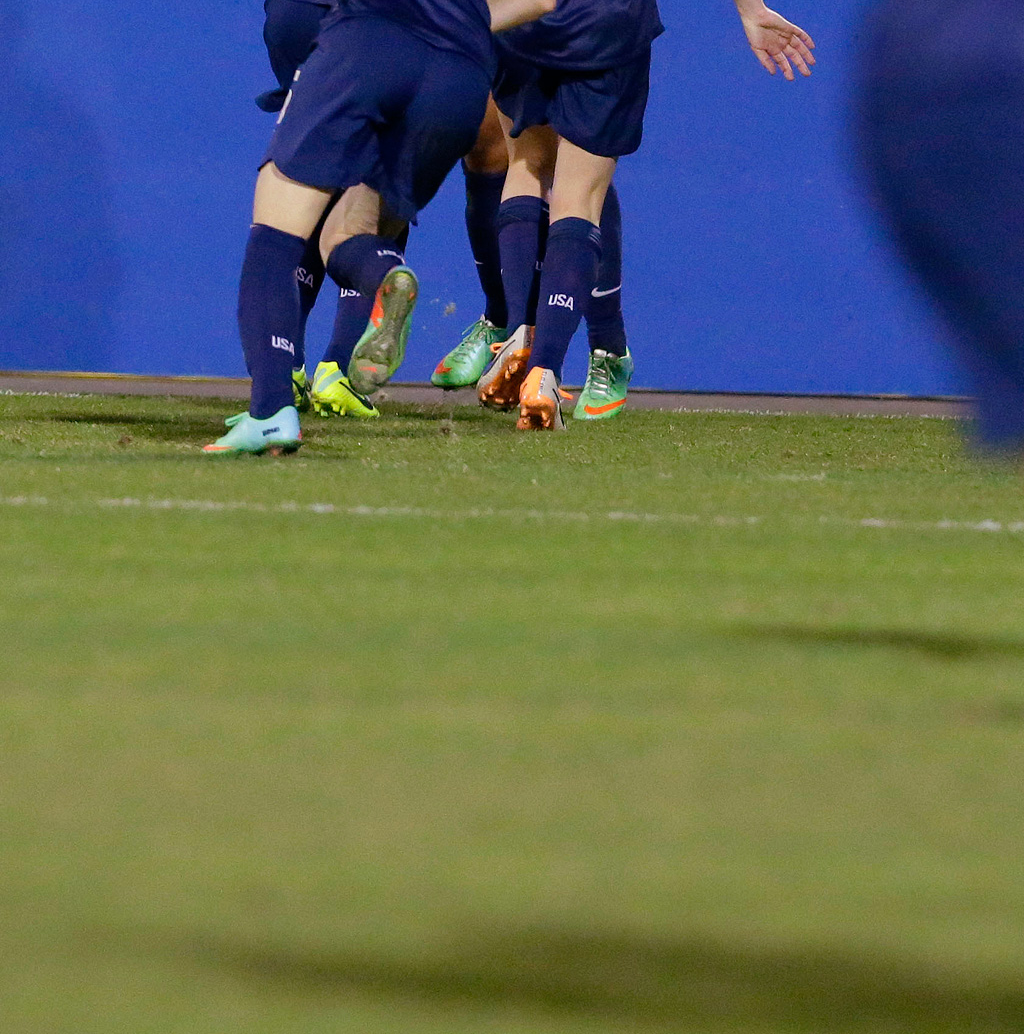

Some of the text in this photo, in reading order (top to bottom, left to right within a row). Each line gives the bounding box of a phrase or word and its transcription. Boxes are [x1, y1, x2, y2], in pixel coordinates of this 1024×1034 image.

[296, 266, 314, 288] SA
[548, 293, 574, 311] USA
[271, 335, 295, 356] USA
